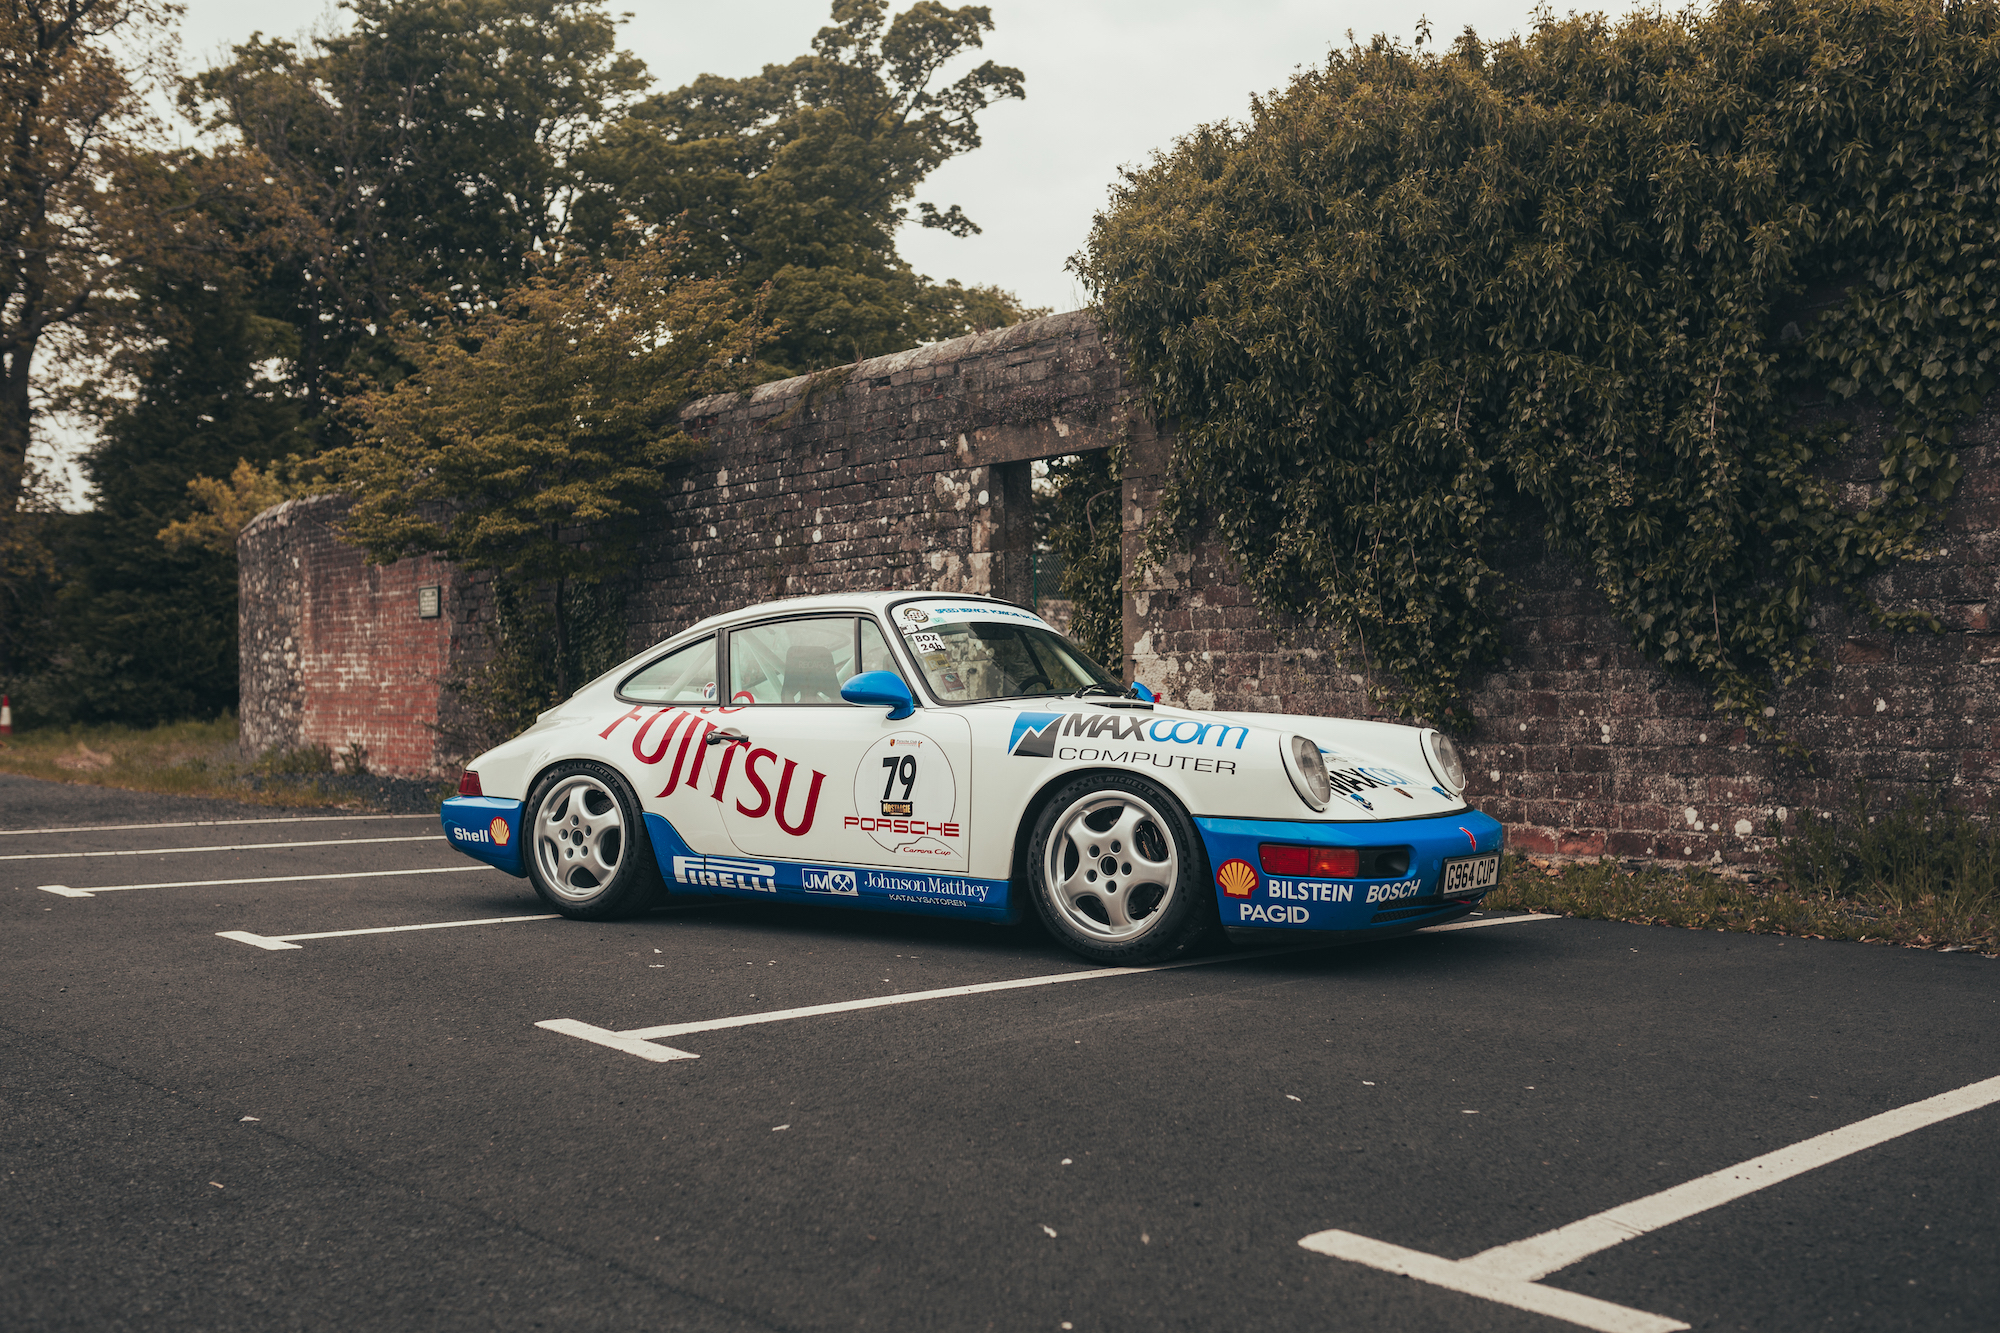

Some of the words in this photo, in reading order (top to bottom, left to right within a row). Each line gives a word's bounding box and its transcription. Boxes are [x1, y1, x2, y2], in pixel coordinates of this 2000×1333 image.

[914, 634, 938, 643] BOX
[798, 660, 829, 669] RECARO
[597, 705, 828, 837] FUJITSU
[1058, 747, 1236, 775] COMPUTER
[585, 763, 618, 788] MICHELIN
[882, 754, 917, 800] 79
[1105, 775, 1156, 797] MICHELIN
[453, 827, 489, 843] Shell
[844, 816, 960, 838] PORSCHE
[903, 846, 933, 854] Carrera
[934, 848, 951, 856] Cup
[672, 855, 777, 893] PIRELLI
[804, 873, 830, 891] JM
[1447, 862, 1475, 890] G964
[1477, 858, 1496, 886] CUP
[864, 872, 927, 892] Johnson
[927, 877, 990, 902] Matthey
[1268, 879, 1354, 902] BILSTEIN
[1365, 879, 1422, 904] BOSCH
[888, 893, 967, 907] KATALYSATOREN
[1239, 903, 1310, 924] PAGID
